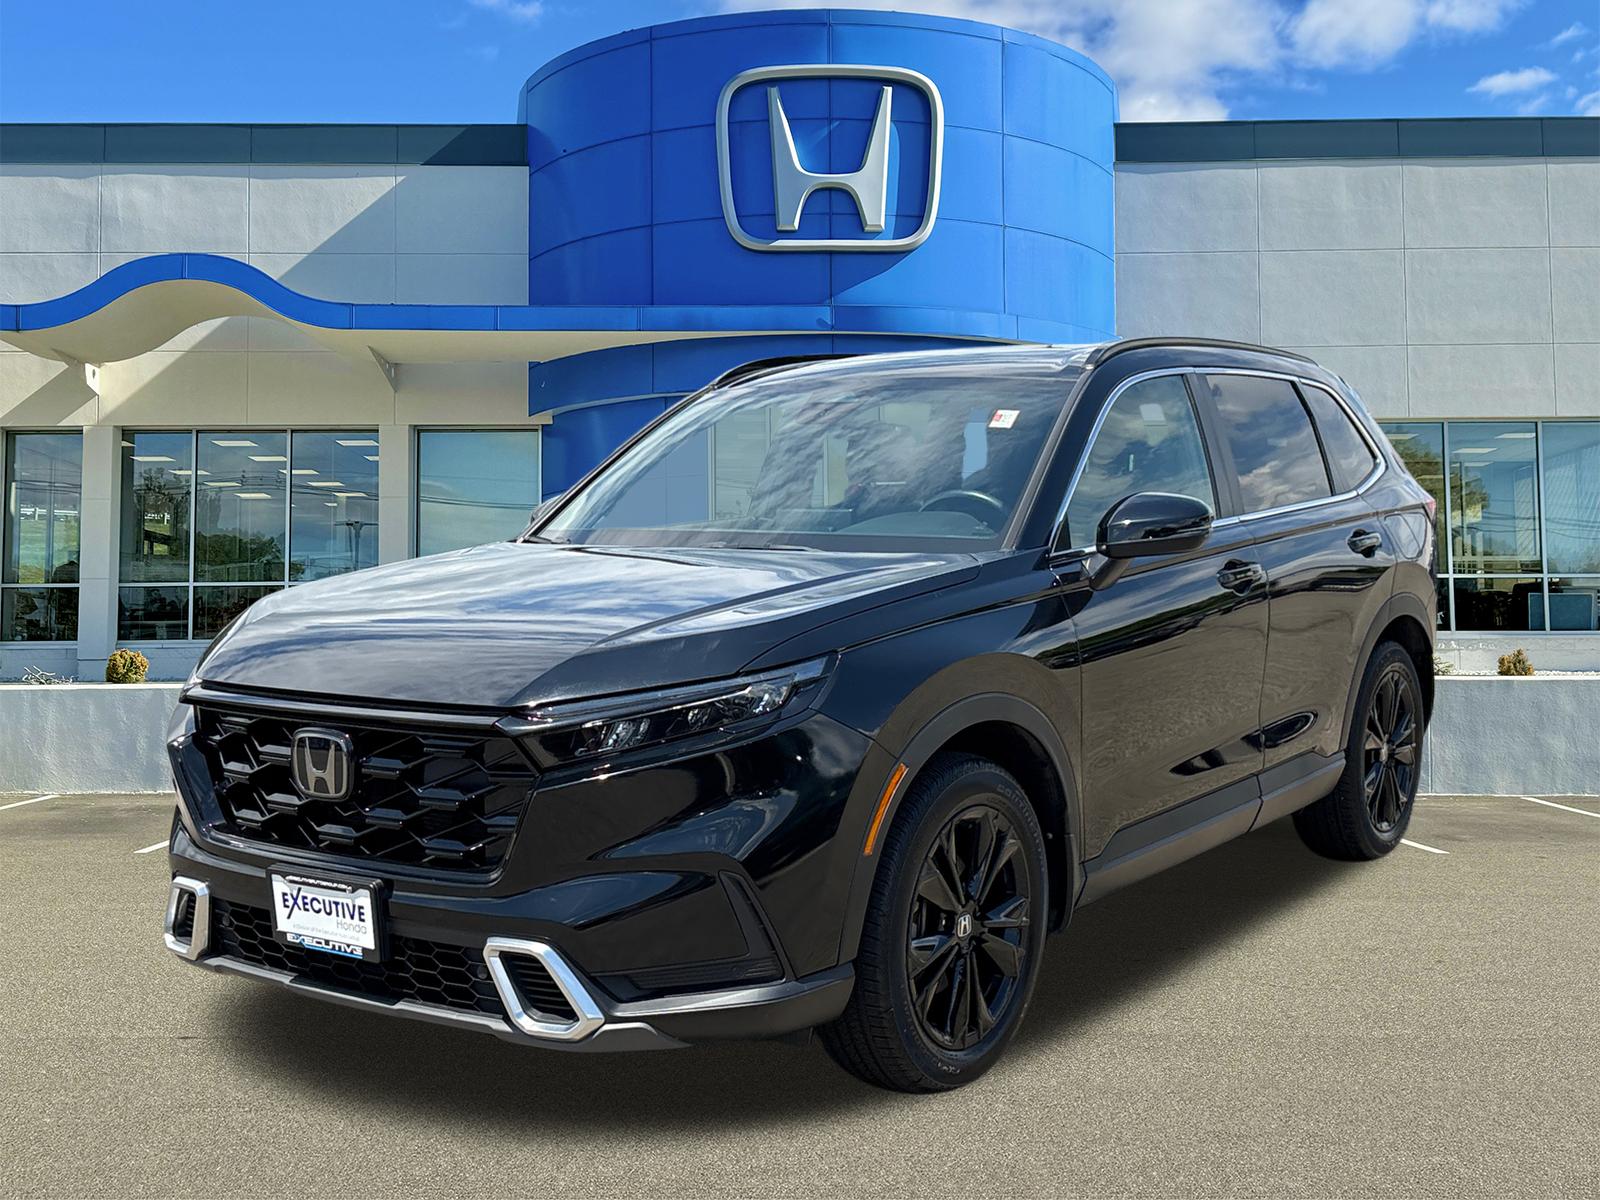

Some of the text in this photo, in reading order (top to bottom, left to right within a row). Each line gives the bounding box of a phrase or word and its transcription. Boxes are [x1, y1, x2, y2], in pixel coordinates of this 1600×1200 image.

[281, 887, 366, 923] EXECUTIVE
[336, 919, 367, 935] Honda
[286, 932, 363, 956] EXECUTIVE
